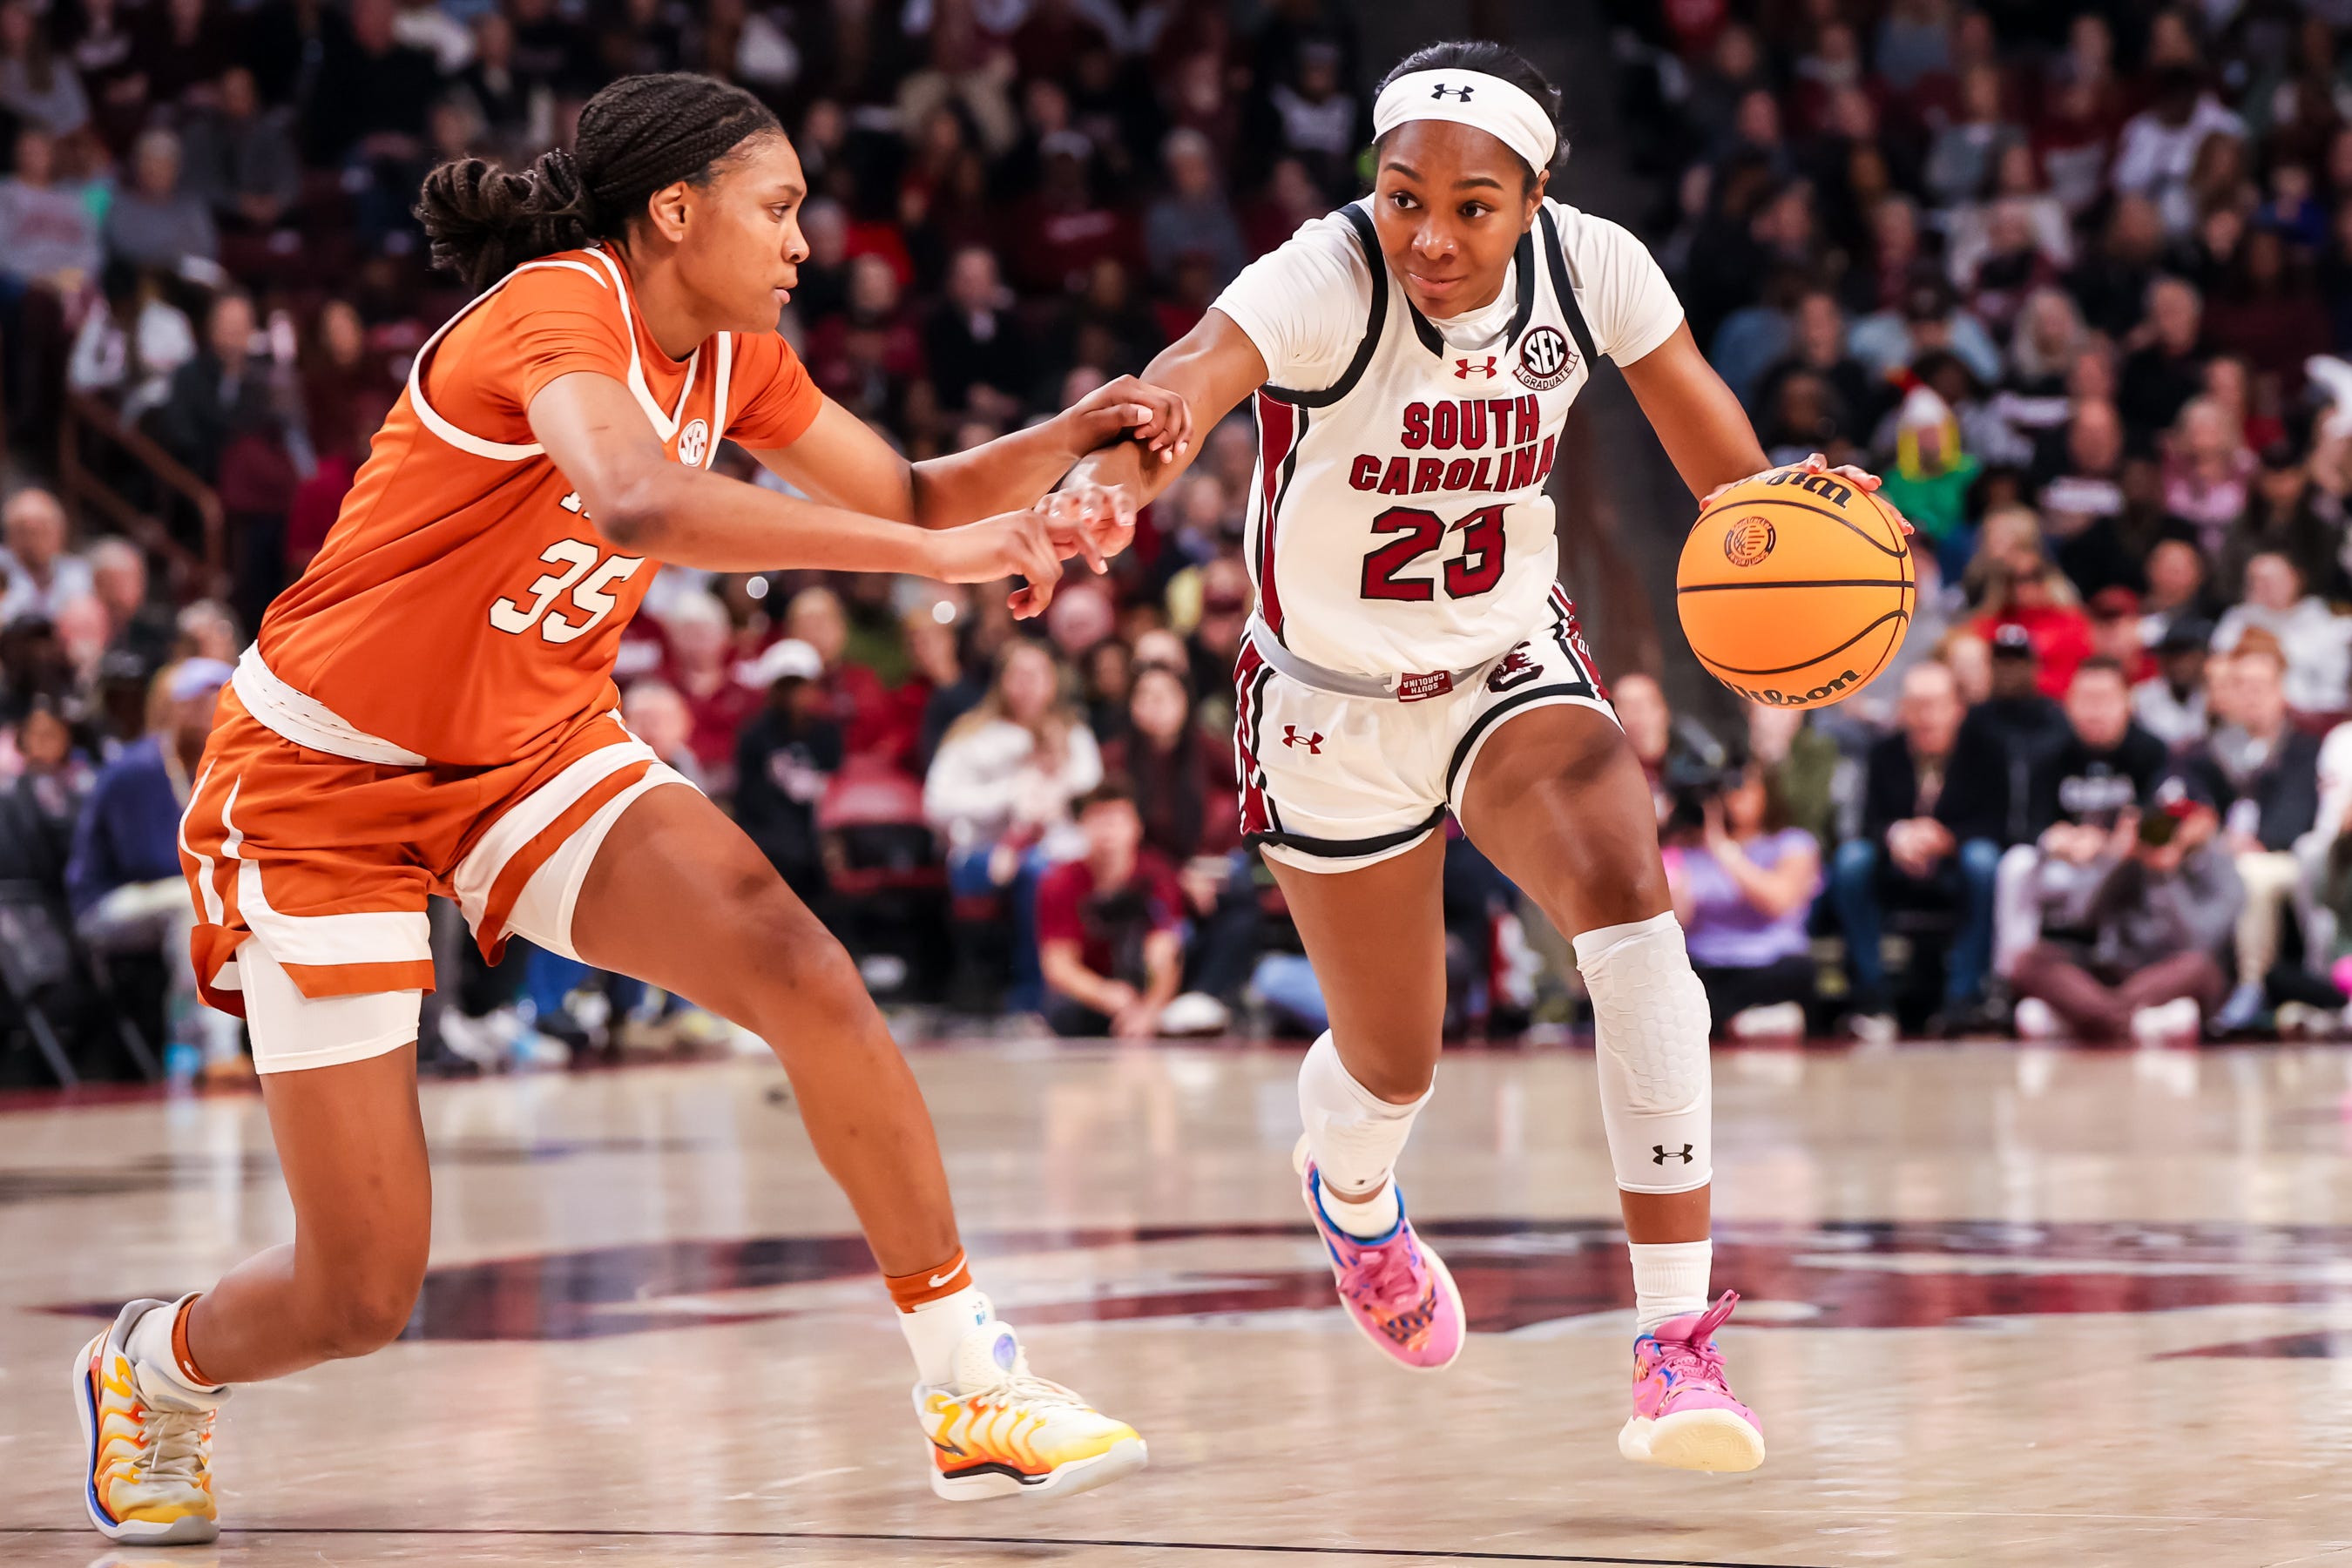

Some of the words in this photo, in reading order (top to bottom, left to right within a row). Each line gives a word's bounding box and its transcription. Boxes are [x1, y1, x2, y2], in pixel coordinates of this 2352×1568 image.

[1523, 365, 1572, 389] GRADUATE
[1524, 330, 1565, 375] SEC
[1400, 394, 1541, 450] SOUTH
[1348, 434, 1555, 495] CAROLINA
[1360, 504, 1516, 602] 23
[489, 537, 647, 644] 35
[1402, 672, 1445, 688] CAROLINA
[1411, 682, 1438, 694] SOUTH
